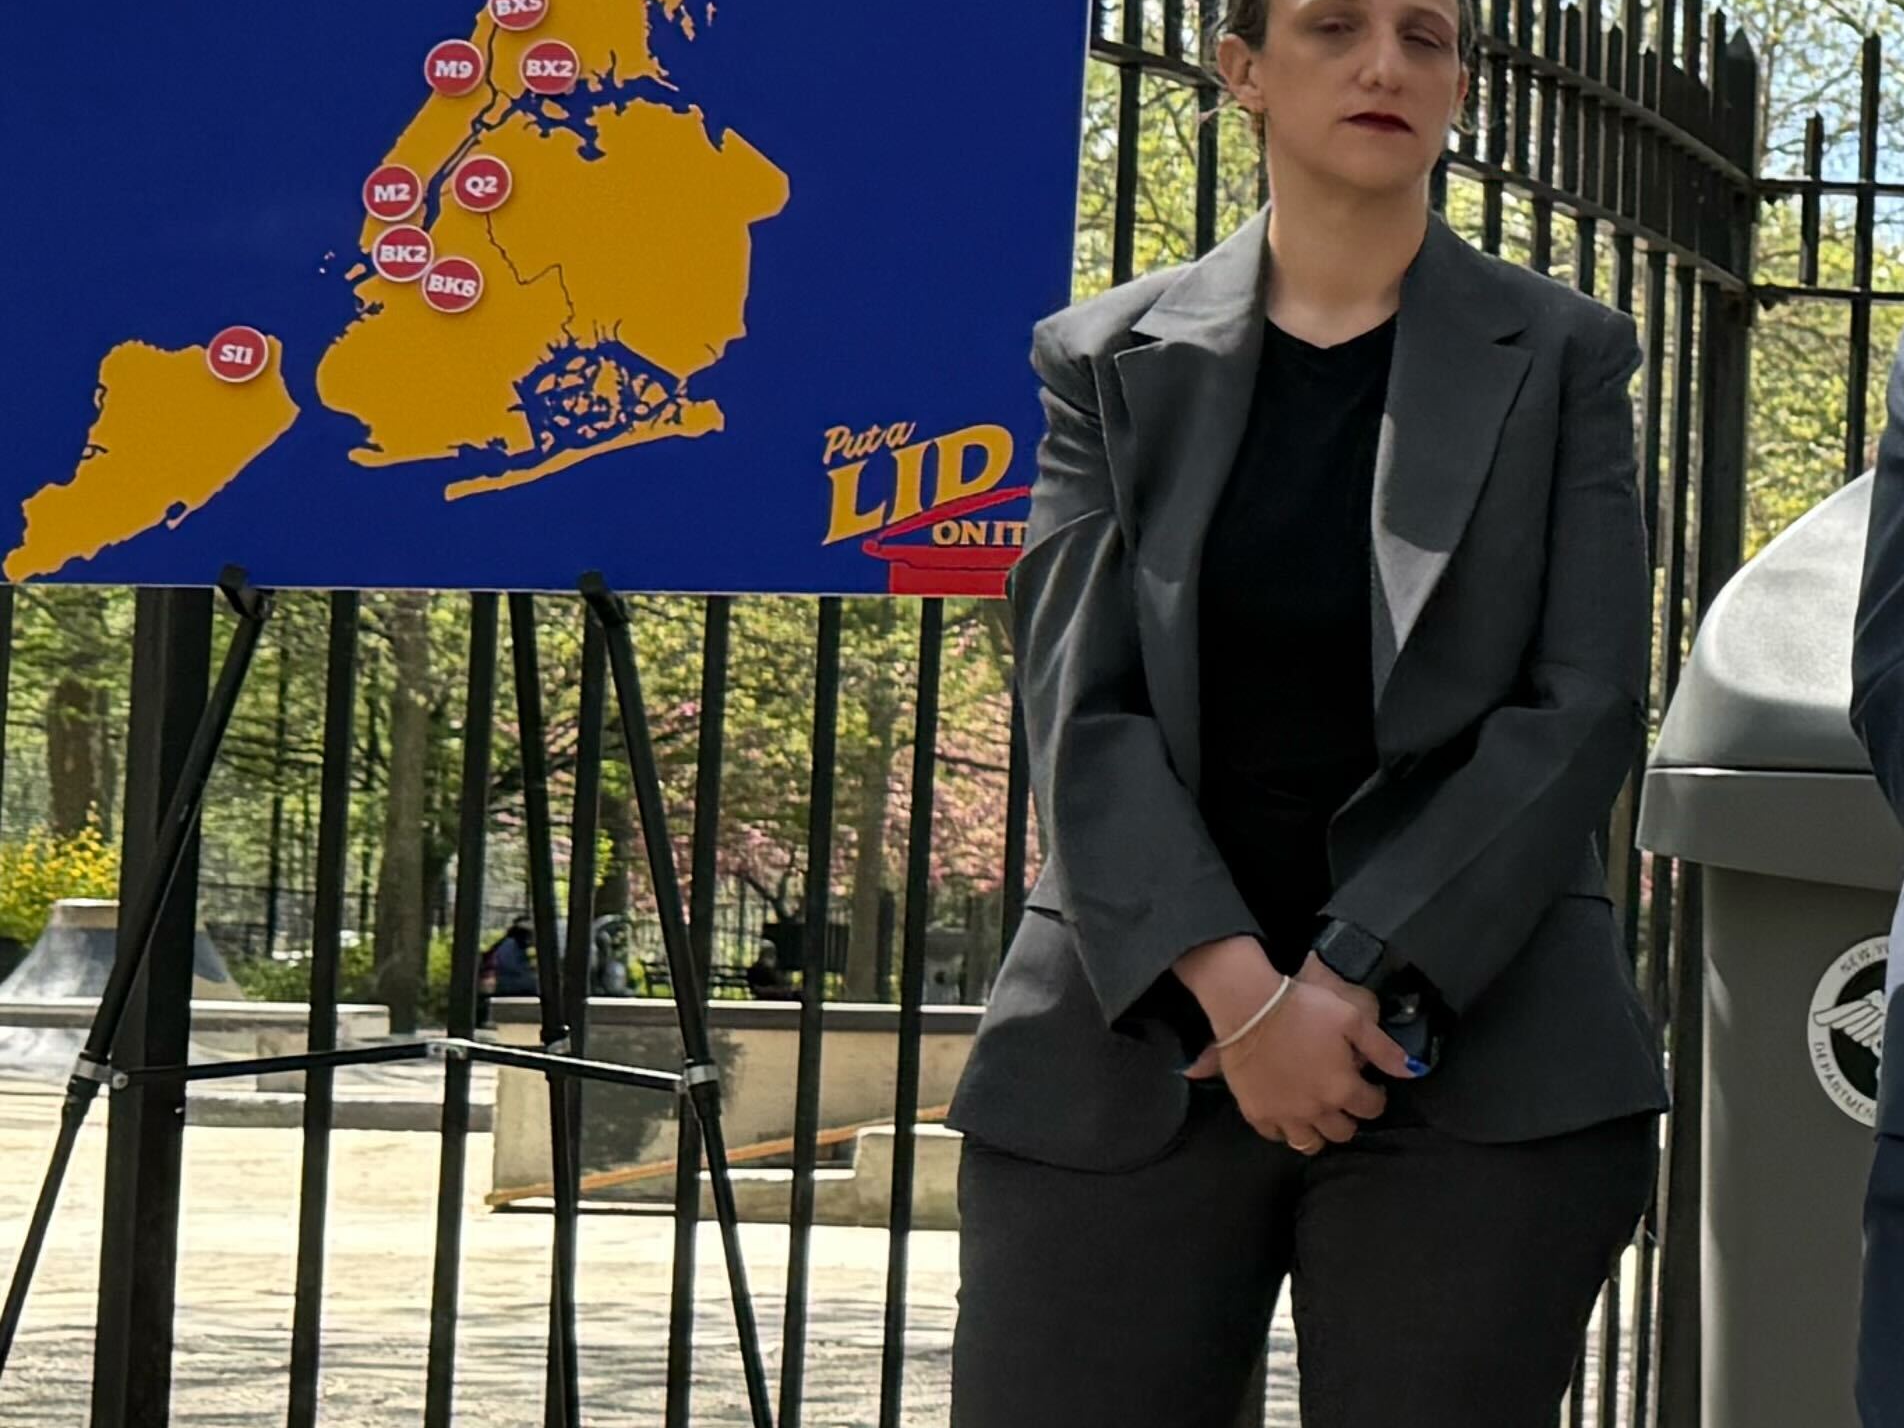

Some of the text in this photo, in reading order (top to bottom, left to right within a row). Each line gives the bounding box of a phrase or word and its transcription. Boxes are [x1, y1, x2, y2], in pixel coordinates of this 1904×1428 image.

[434, 59, 474, 78] M9
[525, 59, 574, 78] BX2
[373, 183, 411, 203] M2
[464, 175, 498, 198] Q2
[379, 244, 427, 263] BK2
[427, 273, 477, 298] BK8
[823, 421, 916, 465] Put a
[821, 424, 1014, 546] LID
[932, 520, 1030, 546] ON IT
[1813, 1040, 1874, 1120] DEPARTMEN
